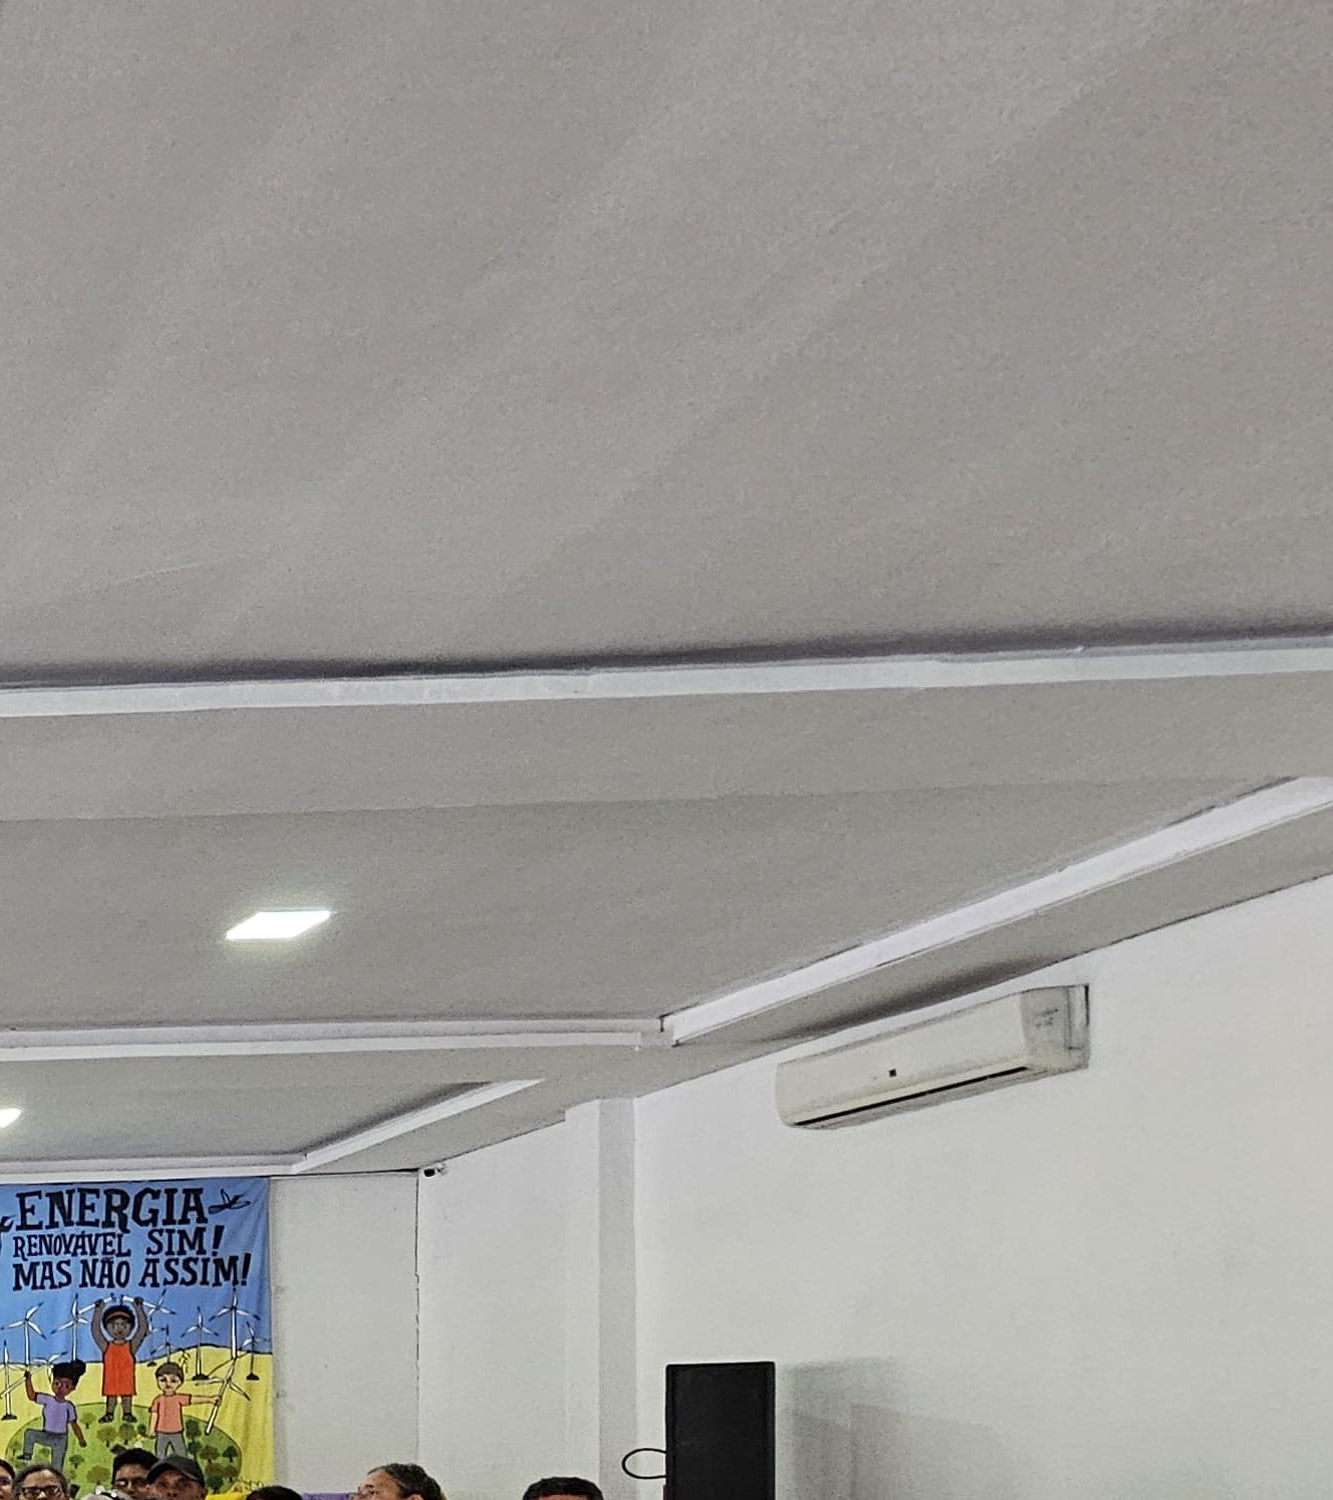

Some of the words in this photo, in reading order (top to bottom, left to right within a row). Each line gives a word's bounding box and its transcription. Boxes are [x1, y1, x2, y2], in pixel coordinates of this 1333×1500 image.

[15, 1187, 209, 1232] ENERGIA
[12, 1230, 132, 1262] RENOVÁVEL
[146, 1225, 225, 1256] SIM!
[12, 1260, 71, 1291] MAS
[78, 1257, 131, 1288] NÃO
[138, 1253, 251, 1287] ASSIM!
